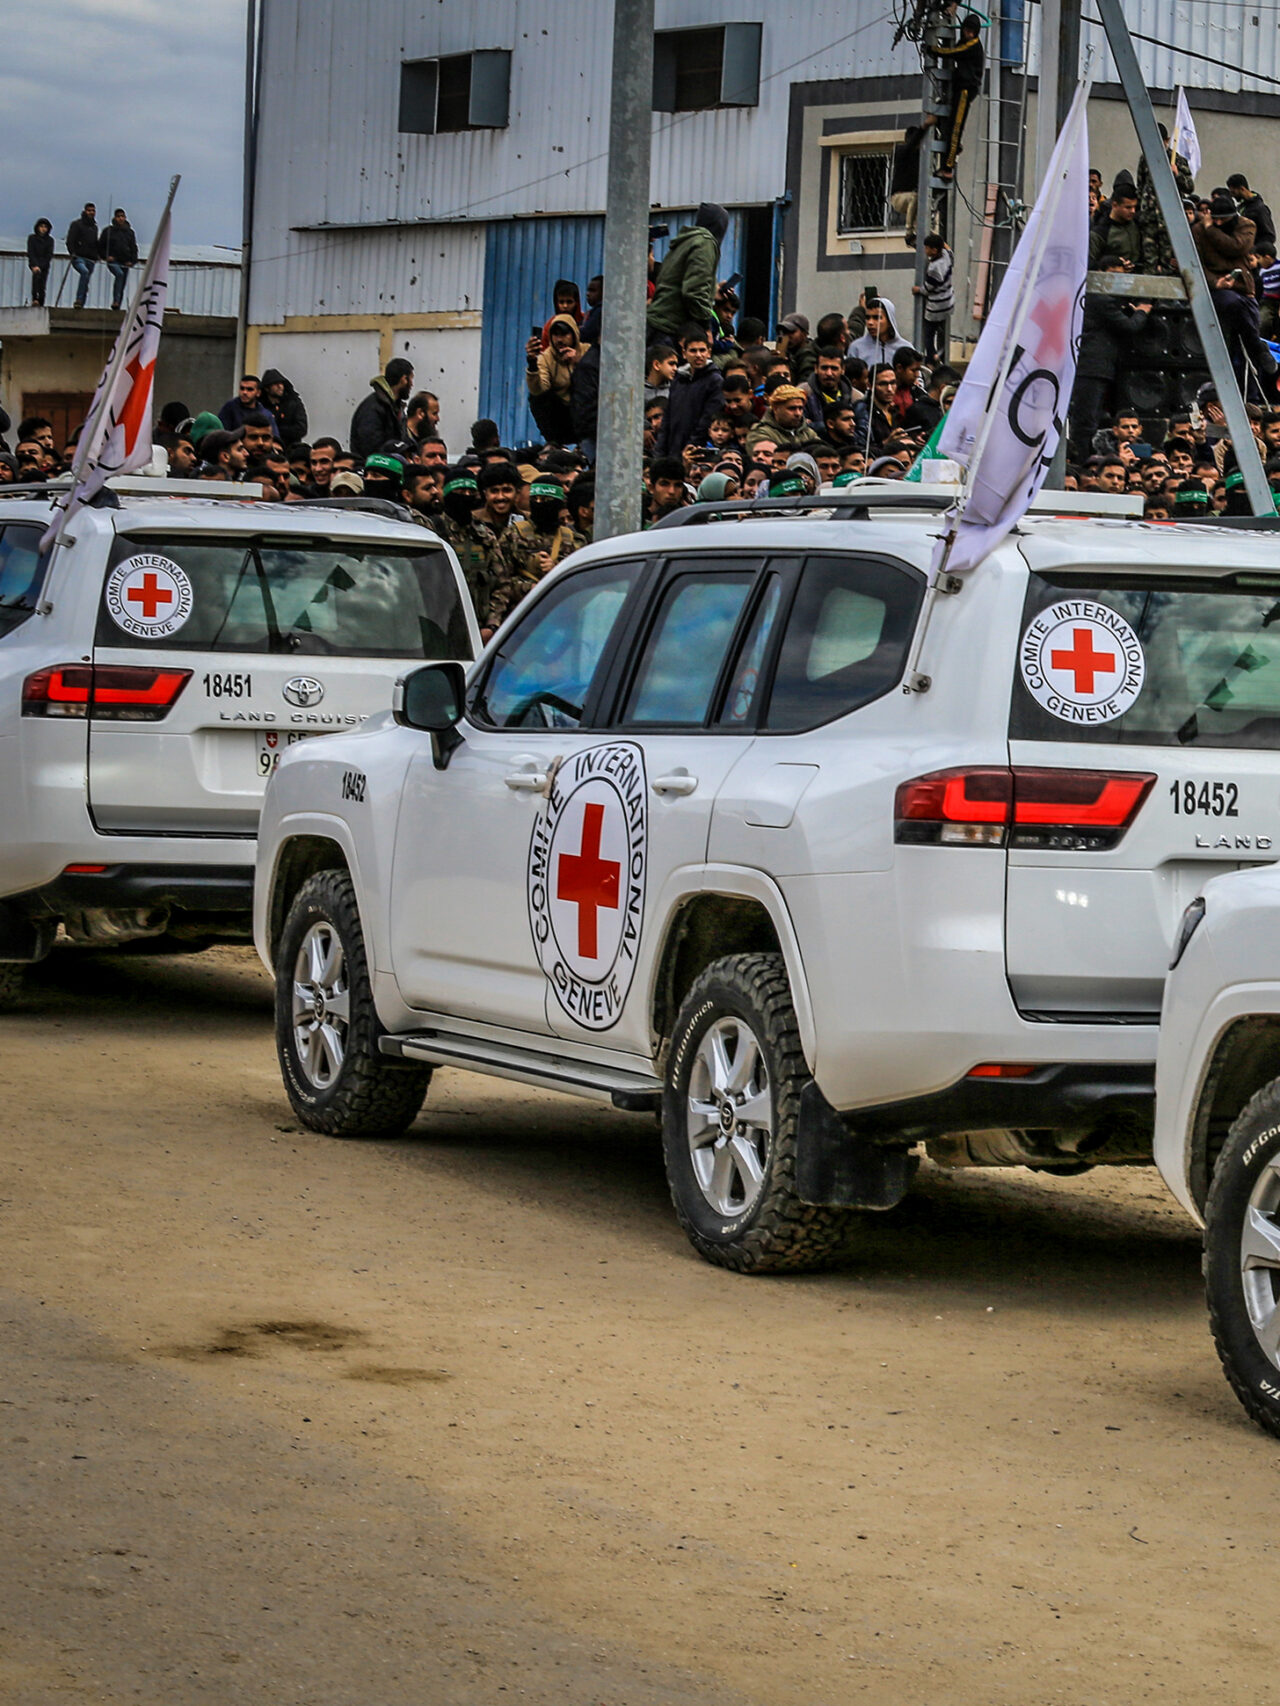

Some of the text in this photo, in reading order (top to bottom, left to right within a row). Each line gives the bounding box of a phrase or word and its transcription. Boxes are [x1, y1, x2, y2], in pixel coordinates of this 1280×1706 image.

[107, 555, 191, 620] COMITE INTERNATIONAL
[123, 619, 175, 636] GENEVE
[1023, 602, 1143, 698] COMITE INTERNATIONAL
[203, 673, 252, 697] 18451
[220, 711, 369, 725] LAND CRUIS
[1046, 695, 1121, 722] GENEVE
[342, 771, 367, 802] 18452
[1169, 779, 1239, 817] 18452
[532, 747, 643, 960] COMITE INTERNATIONAL
[1195, 834, 1273, 850] LAND
[553, 961, 621, 1021] GENEVE
